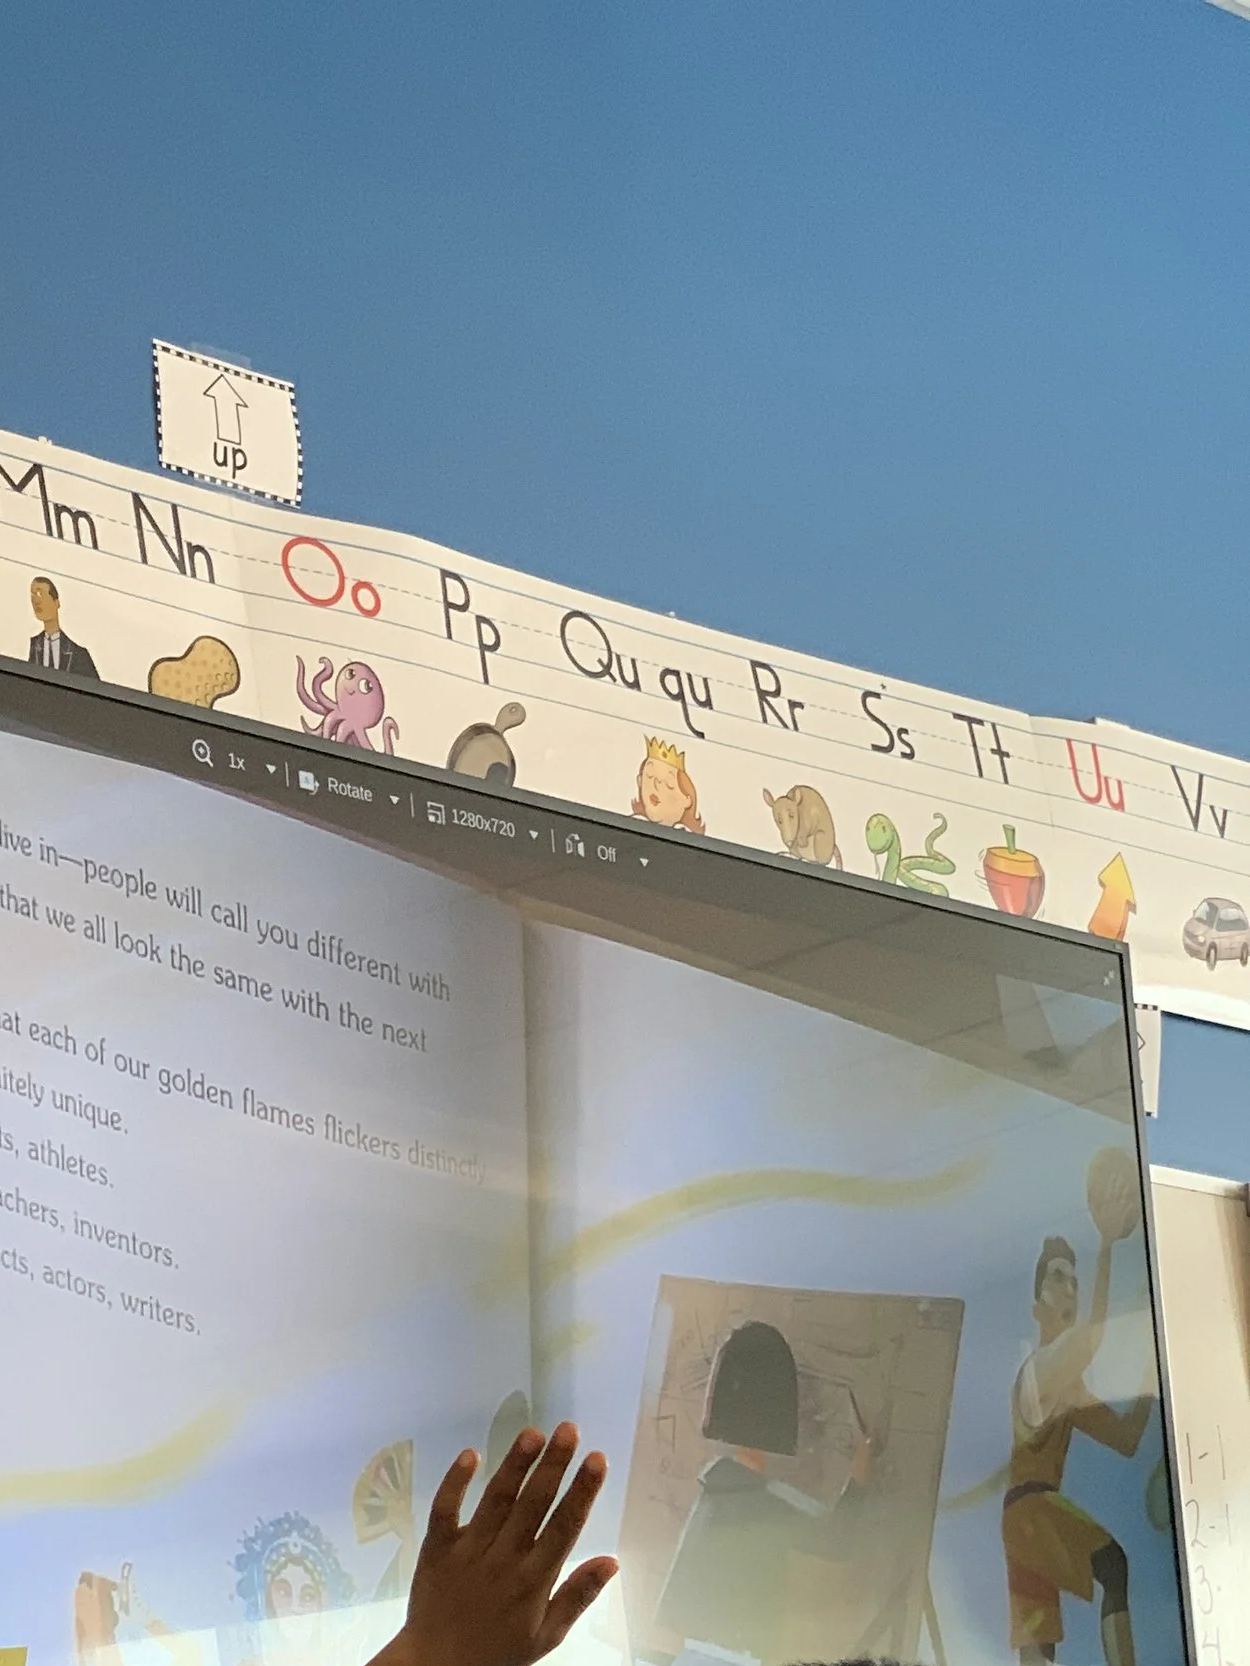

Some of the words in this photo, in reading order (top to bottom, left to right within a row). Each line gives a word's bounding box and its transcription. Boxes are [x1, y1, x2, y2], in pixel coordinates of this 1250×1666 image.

[212, 441, 248, 475] up
[132, 492, 216, 584] Nn
[281, 536, 381, 618] Oo
[439, 568, 501, 685] Pp
[559, 609, 641, 692] Qu
[659, 668, 714, 739] qu
[749, 659, 806, 734] Rr
[859, 691, 916, 760] Ss
[952, 713, 1011, 785] Tt
[1065, 738, 1125, 814] Uu
[1171, 765, 1230, 839] Vv
[227, 752, 246, 771] 1x
[326, 775, 373, 804] Rotate
[450, 808, 517, 840] 1280x720
[596, 843, 617, 863] Off
[0, 885, 39, 922] that
[46, 907, 76, 934] we
[83, 914, 107, 945] all
[114, 920, 162, 965] look
[170, 944, 205, 979] the
[214, 964, 273, 1002] same
[281, 988, 330, 1023] with
[338, 1001, 373, 1036] the
[382, 1022, 429, 1054] next
[166, 885, 203, 918] will
[210, 902, 248, 934] call
[257, 917, 299, 951] you
[307, 930, 401, 987] different
[408, 968, 451, 1002] with
[28, 1020, 78, 1056] each
[85, 1037, 107, 1066] of
[114, 1052, 150, 1081] our
[158, 1066, 234, 1111] golden
[242, 1087, 315, 1136] flames
[324, 1113, 400, 1161] flickers
[52, 1089, 129, 1135] unique.
[27, 1138, 115, 1189] athletes.
[73, 1211, 180, 1270] inventors.
[42, 1262, 113, 1310] actors,
[120, 1290, 202, 1336] writers.
